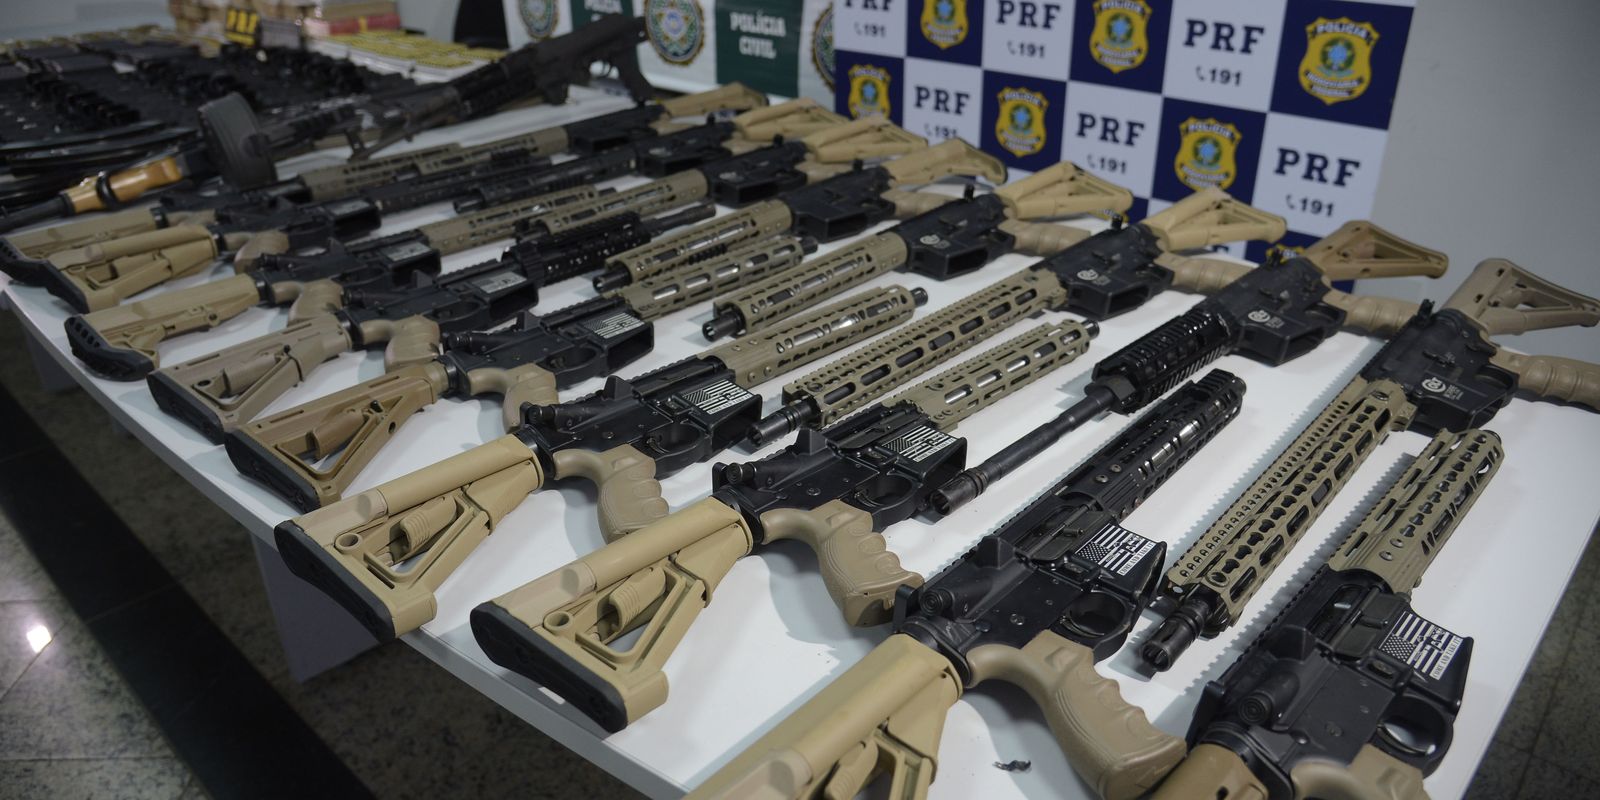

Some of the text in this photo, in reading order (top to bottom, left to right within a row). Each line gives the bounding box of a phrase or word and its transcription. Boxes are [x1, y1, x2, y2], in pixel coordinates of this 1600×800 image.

[996, 0, 1060, 29] PRF
[739, 36, 777, 59] CIVIL
[1183, 18, 1264, 54] PRF
[1018, 43, 1046, 59] 191
[1210, 68, 1242, 87] 191
[915, 85, 970, 115] PRF
[1076, 112, 1145, 146] PRF
[1100, 157, 1127, 174] 191
[1274, 147, 1360, 187] PRF
[1300, 197, 1334, 217] 191
